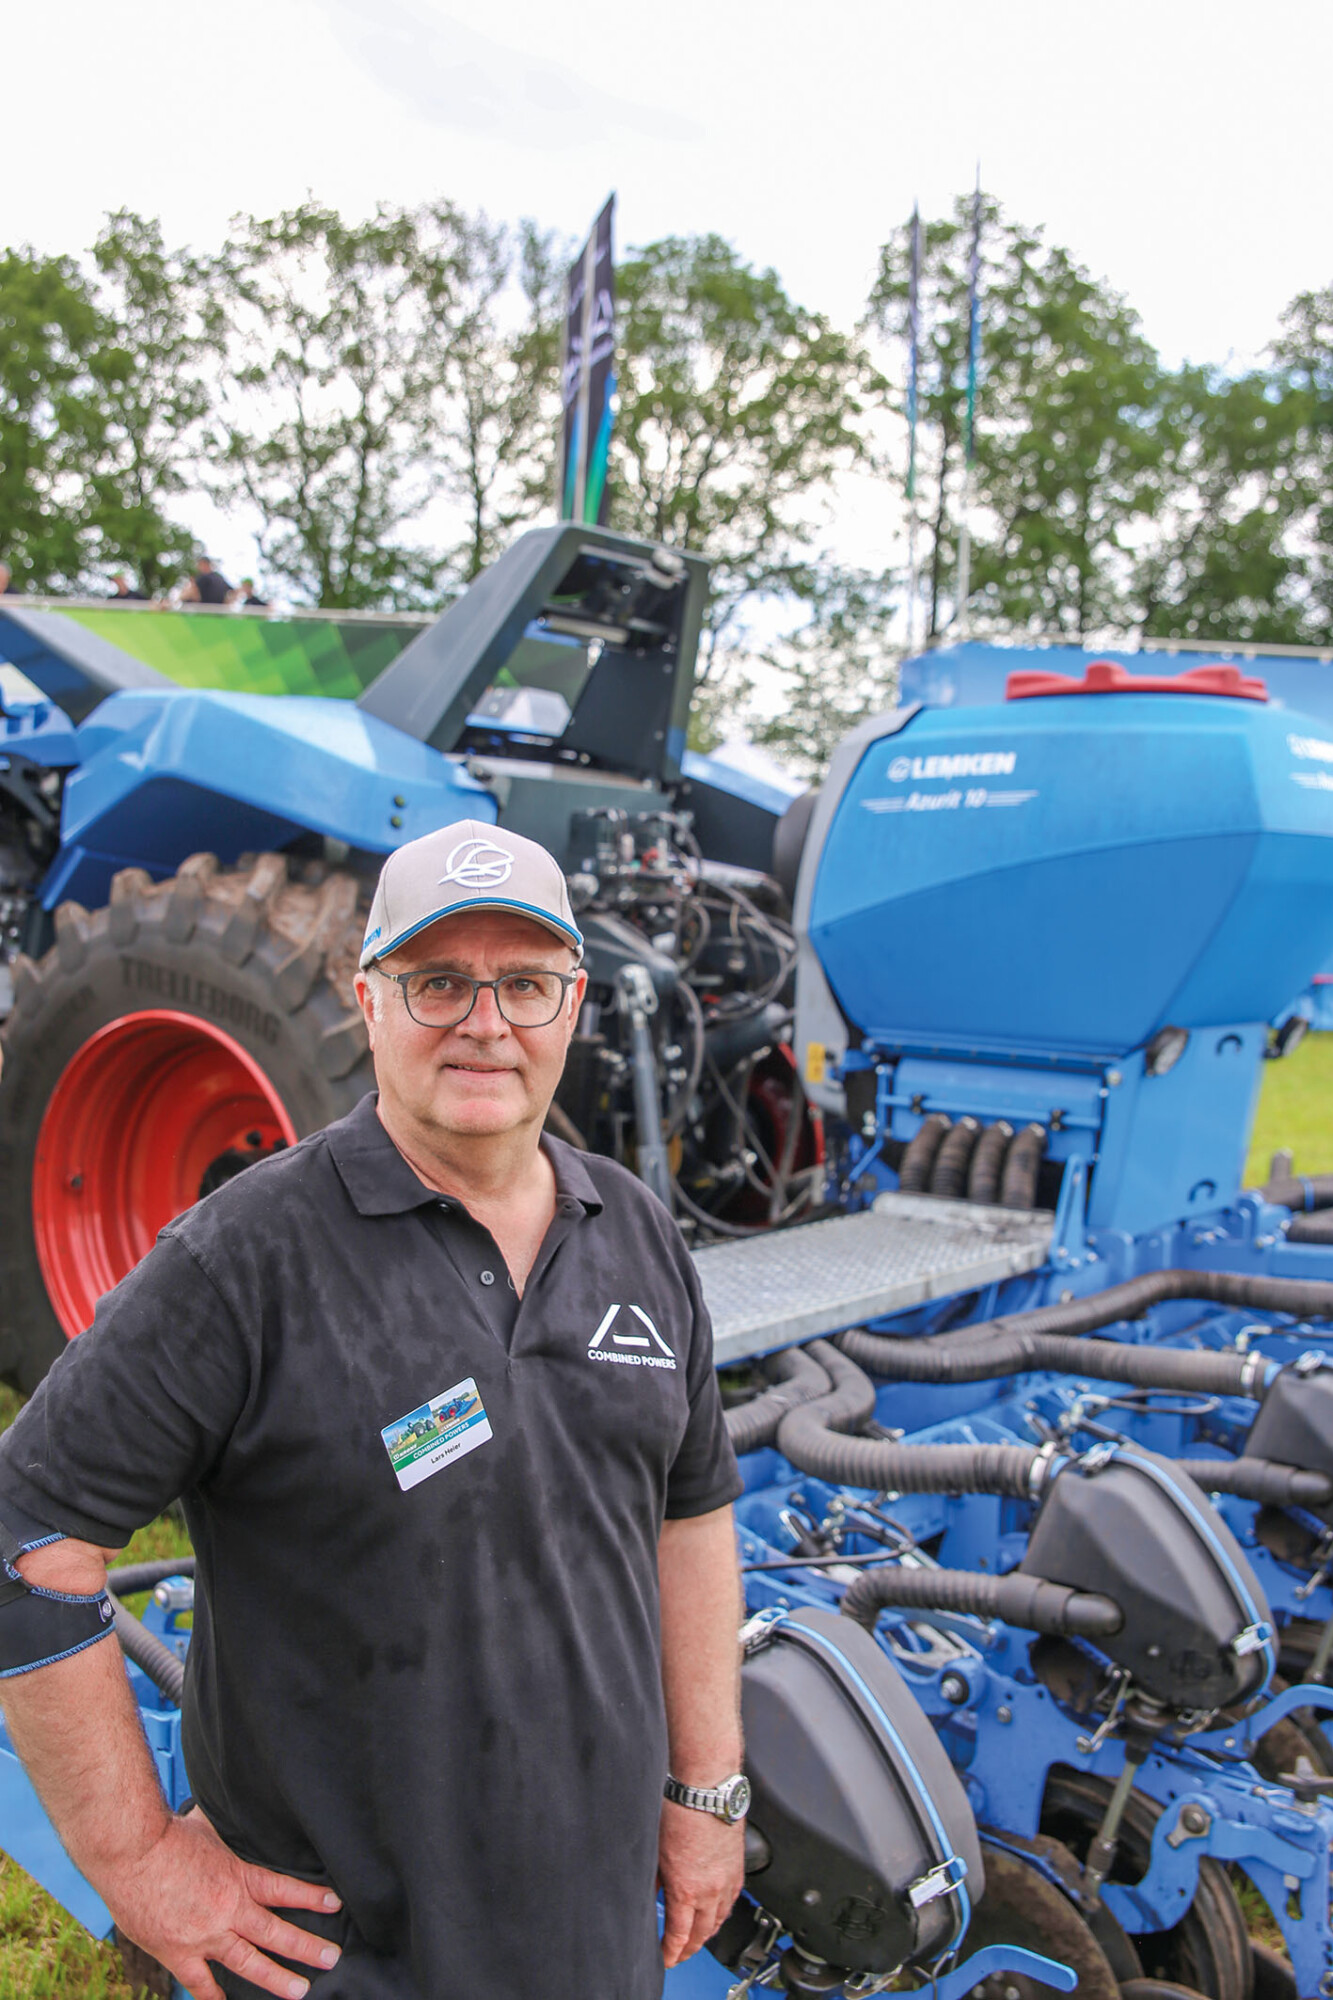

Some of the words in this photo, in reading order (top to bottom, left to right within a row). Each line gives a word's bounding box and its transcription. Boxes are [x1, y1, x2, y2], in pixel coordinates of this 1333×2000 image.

[911, 752, 1016, 779] LEMKEN
[965, 787, 987, 808] 10
[120, 954, 281, 1045] TRELLEBORG
[588, 1349, 641, 1365] COMBINED
[641, 1355, 677, 1370] POWERS
[413, 1435, 445, 1459] COMBINED
[445, 1421, 470, 1442] POWERS
[431, 1452, 445, 1464] Lars
[444, 1442, 461, 1456] Heier
